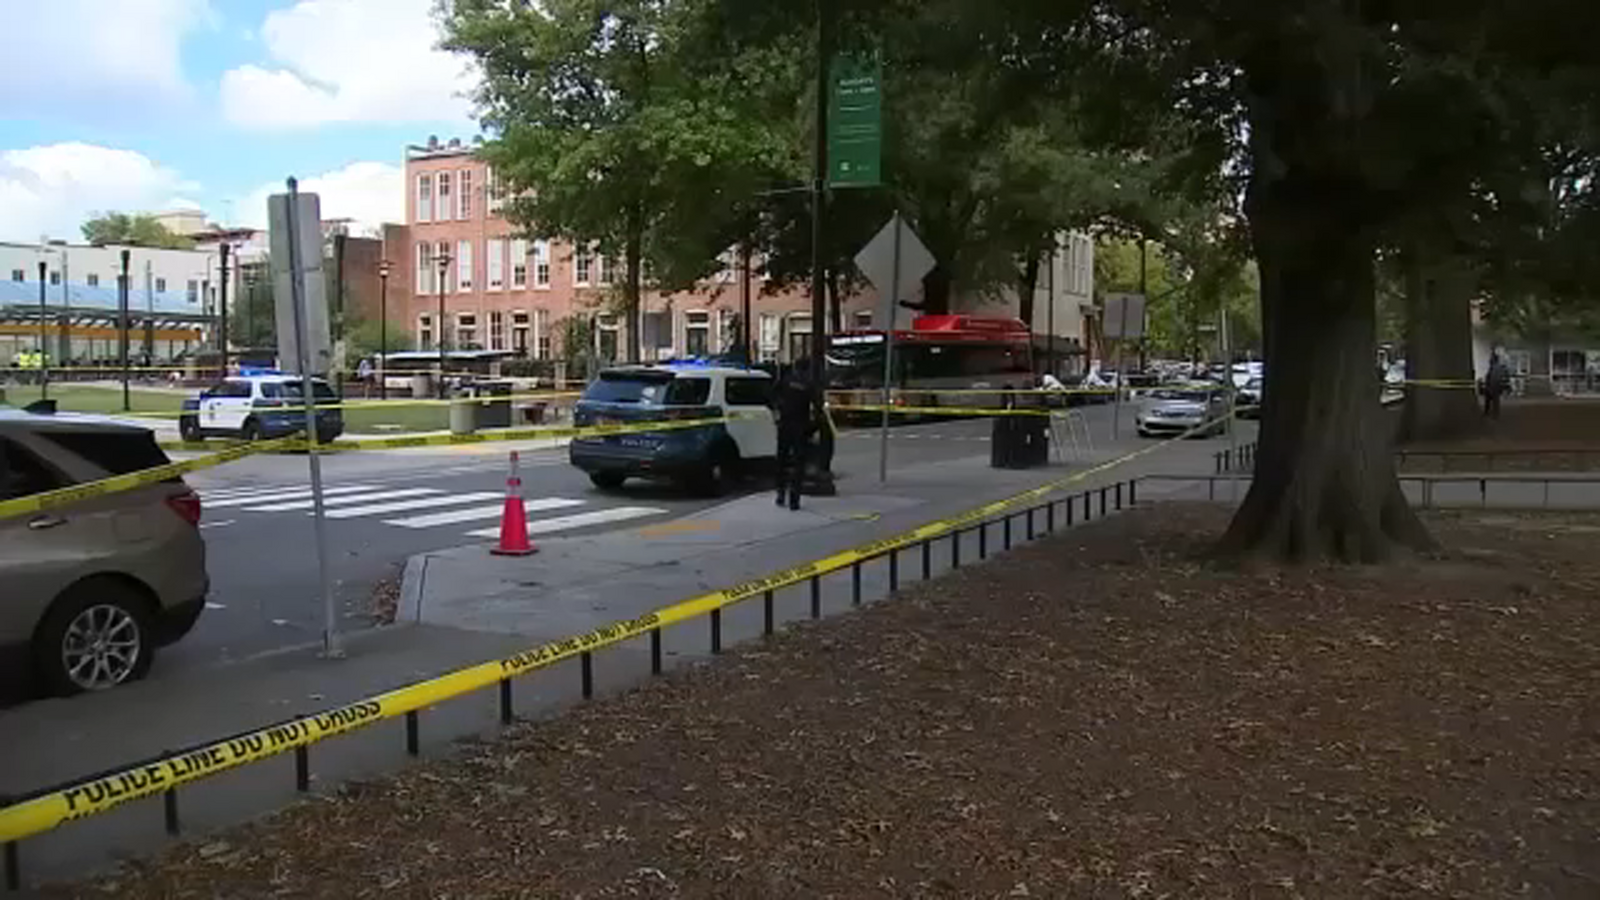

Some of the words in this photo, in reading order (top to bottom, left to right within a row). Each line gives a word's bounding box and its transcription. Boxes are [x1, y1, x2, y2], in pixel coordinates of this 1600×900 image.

[63, 766, 165, 810] POLICE
[168, 747, 226, 776] LINE
[229, 734, 264, 758] DO
[267, 721, 309, 746] NOT
[315, 702, 382, 731] CROSS
